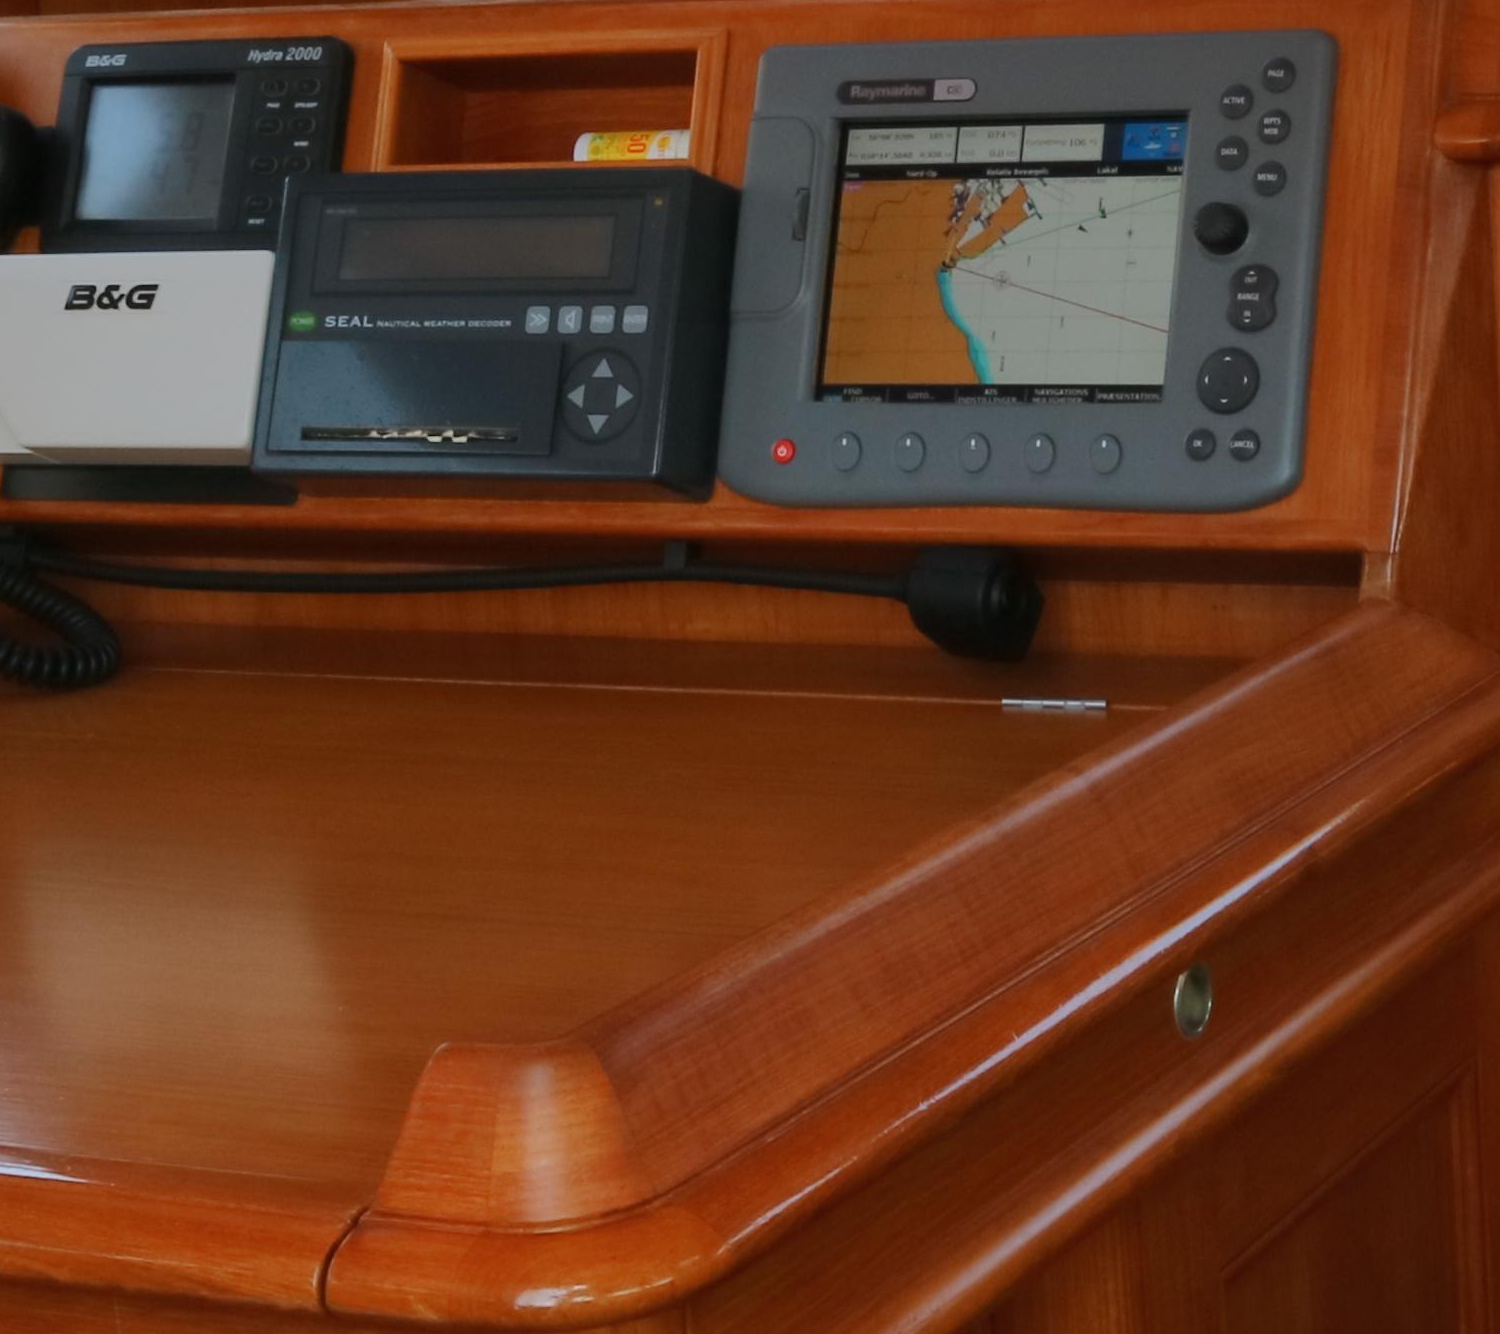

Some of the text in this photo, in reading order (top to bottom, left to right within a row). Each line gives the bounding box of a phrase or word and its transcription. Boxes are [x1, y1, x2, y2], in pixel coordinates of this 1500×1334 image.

[85, 54, 127, 67] B&G
[248, 46, 323, 63] Hydra 2000
[850, 84, 926, 100] Raymarine
[1223, 96, 1245, 104] ACTIVE
[64, 284, 159, 310] B&G
[324, 316, 512, 328] SEAL NAUTICAL WEATHER DECODER
